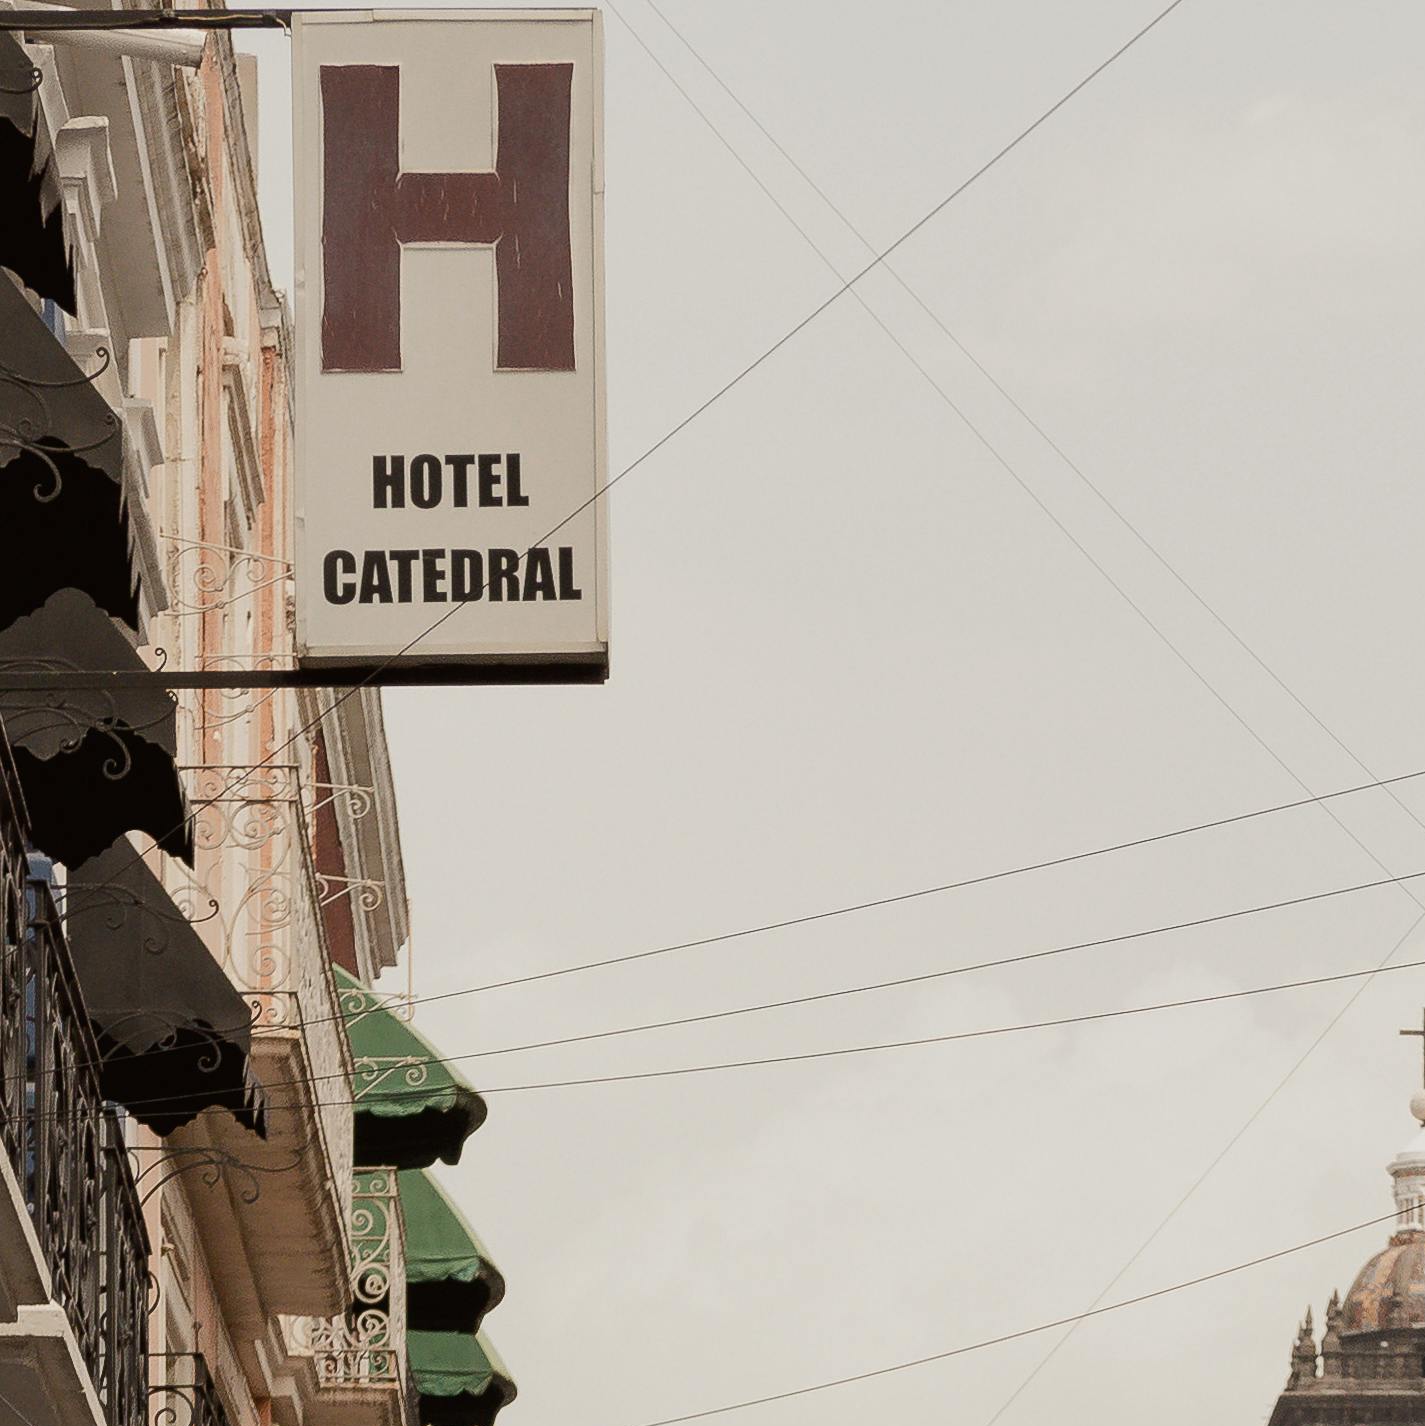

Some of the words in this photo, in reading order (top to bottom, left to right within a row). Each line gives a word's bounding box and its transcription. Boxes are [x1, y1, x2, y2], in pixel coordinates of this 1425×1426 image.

[320, 62, 576, 372] H
[372, 453, 530, 510] HOTEL
[323, 547, 582, 605] CATEDRAL
